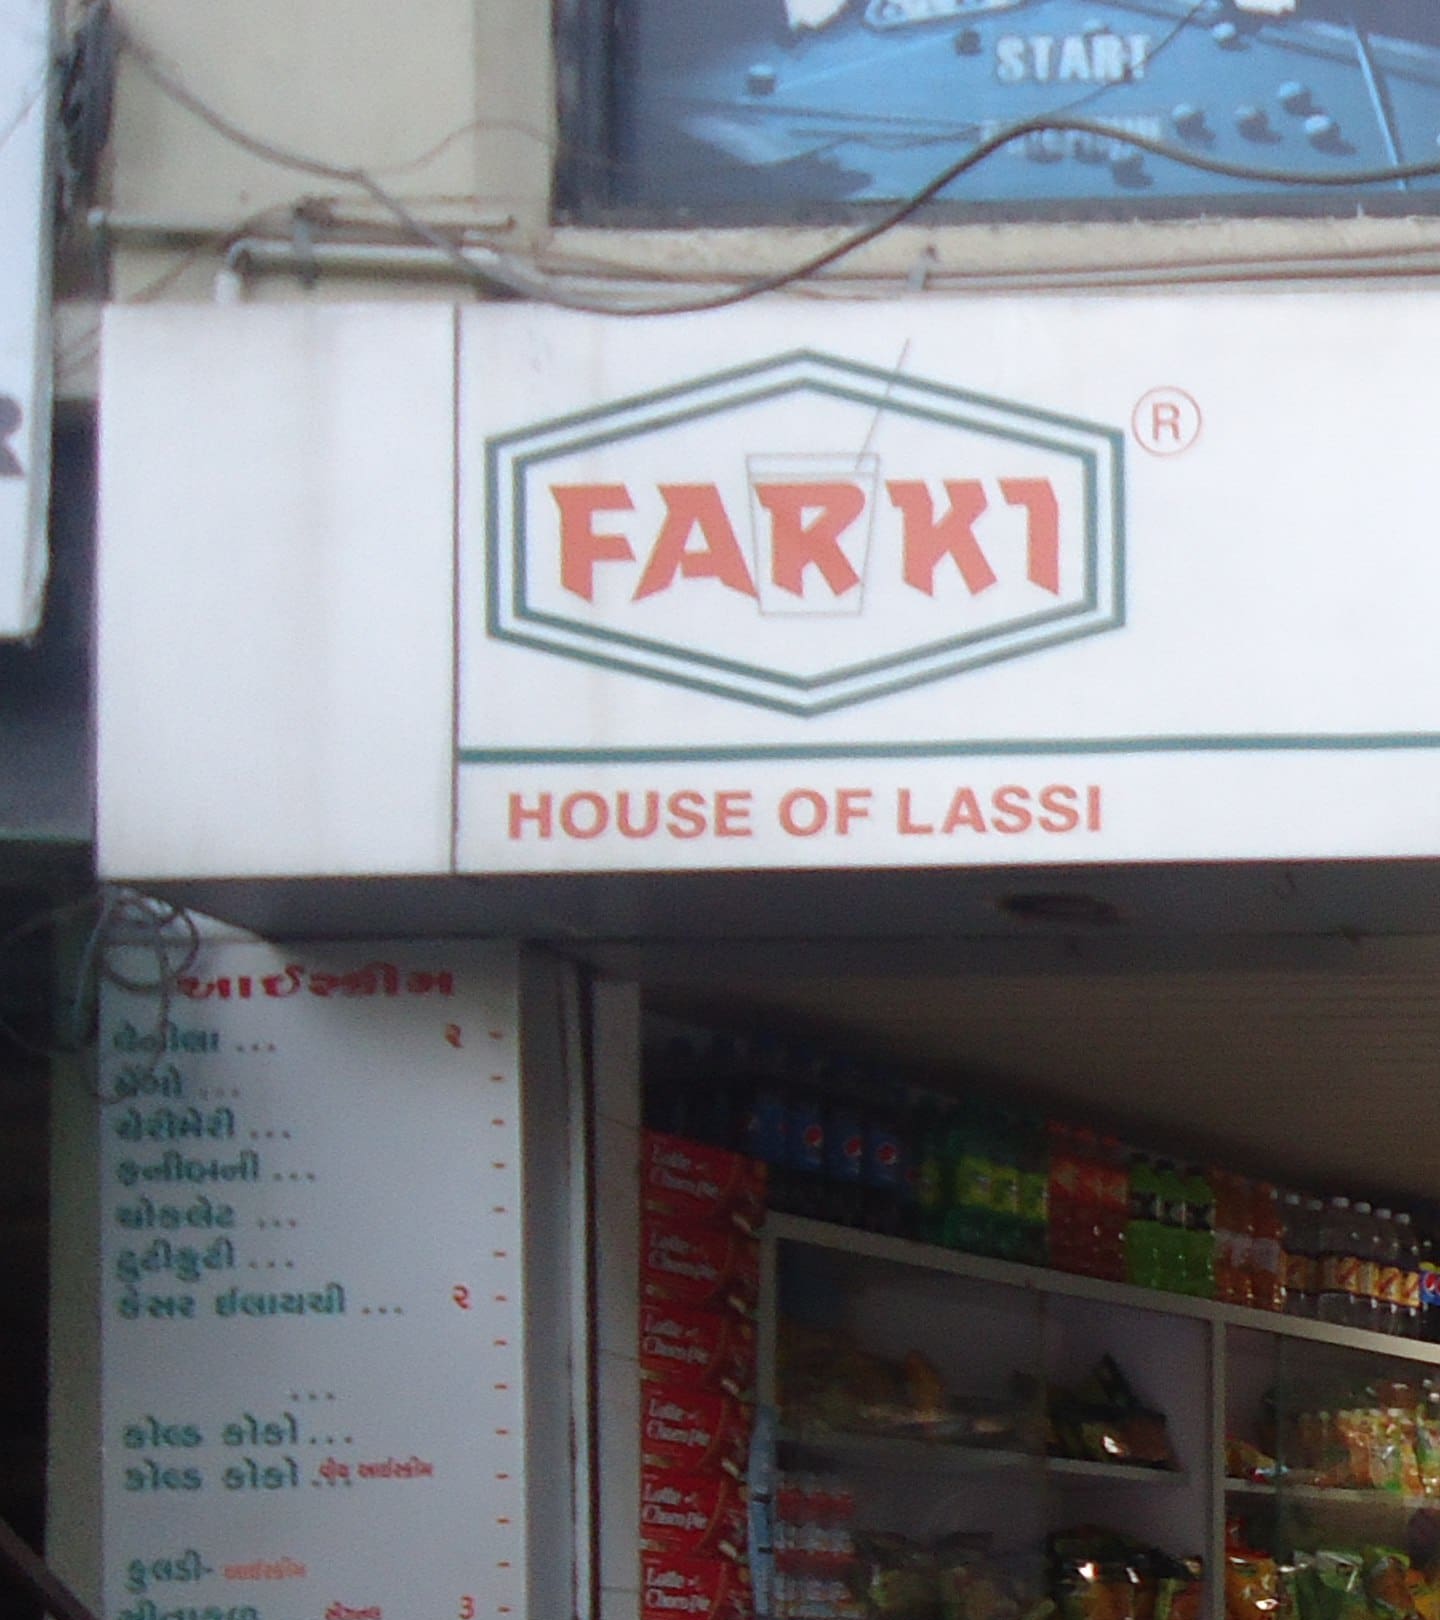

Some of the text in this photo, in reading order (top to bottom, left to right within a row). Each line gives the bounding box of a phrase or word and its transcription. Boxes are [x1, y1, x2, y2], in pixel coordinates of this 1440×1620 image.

[997, 33, 1150, 82] START
[549, 476, 1061, 601] FARKI
[507, 783, 1104, 840] HOUSE OF LASSI
